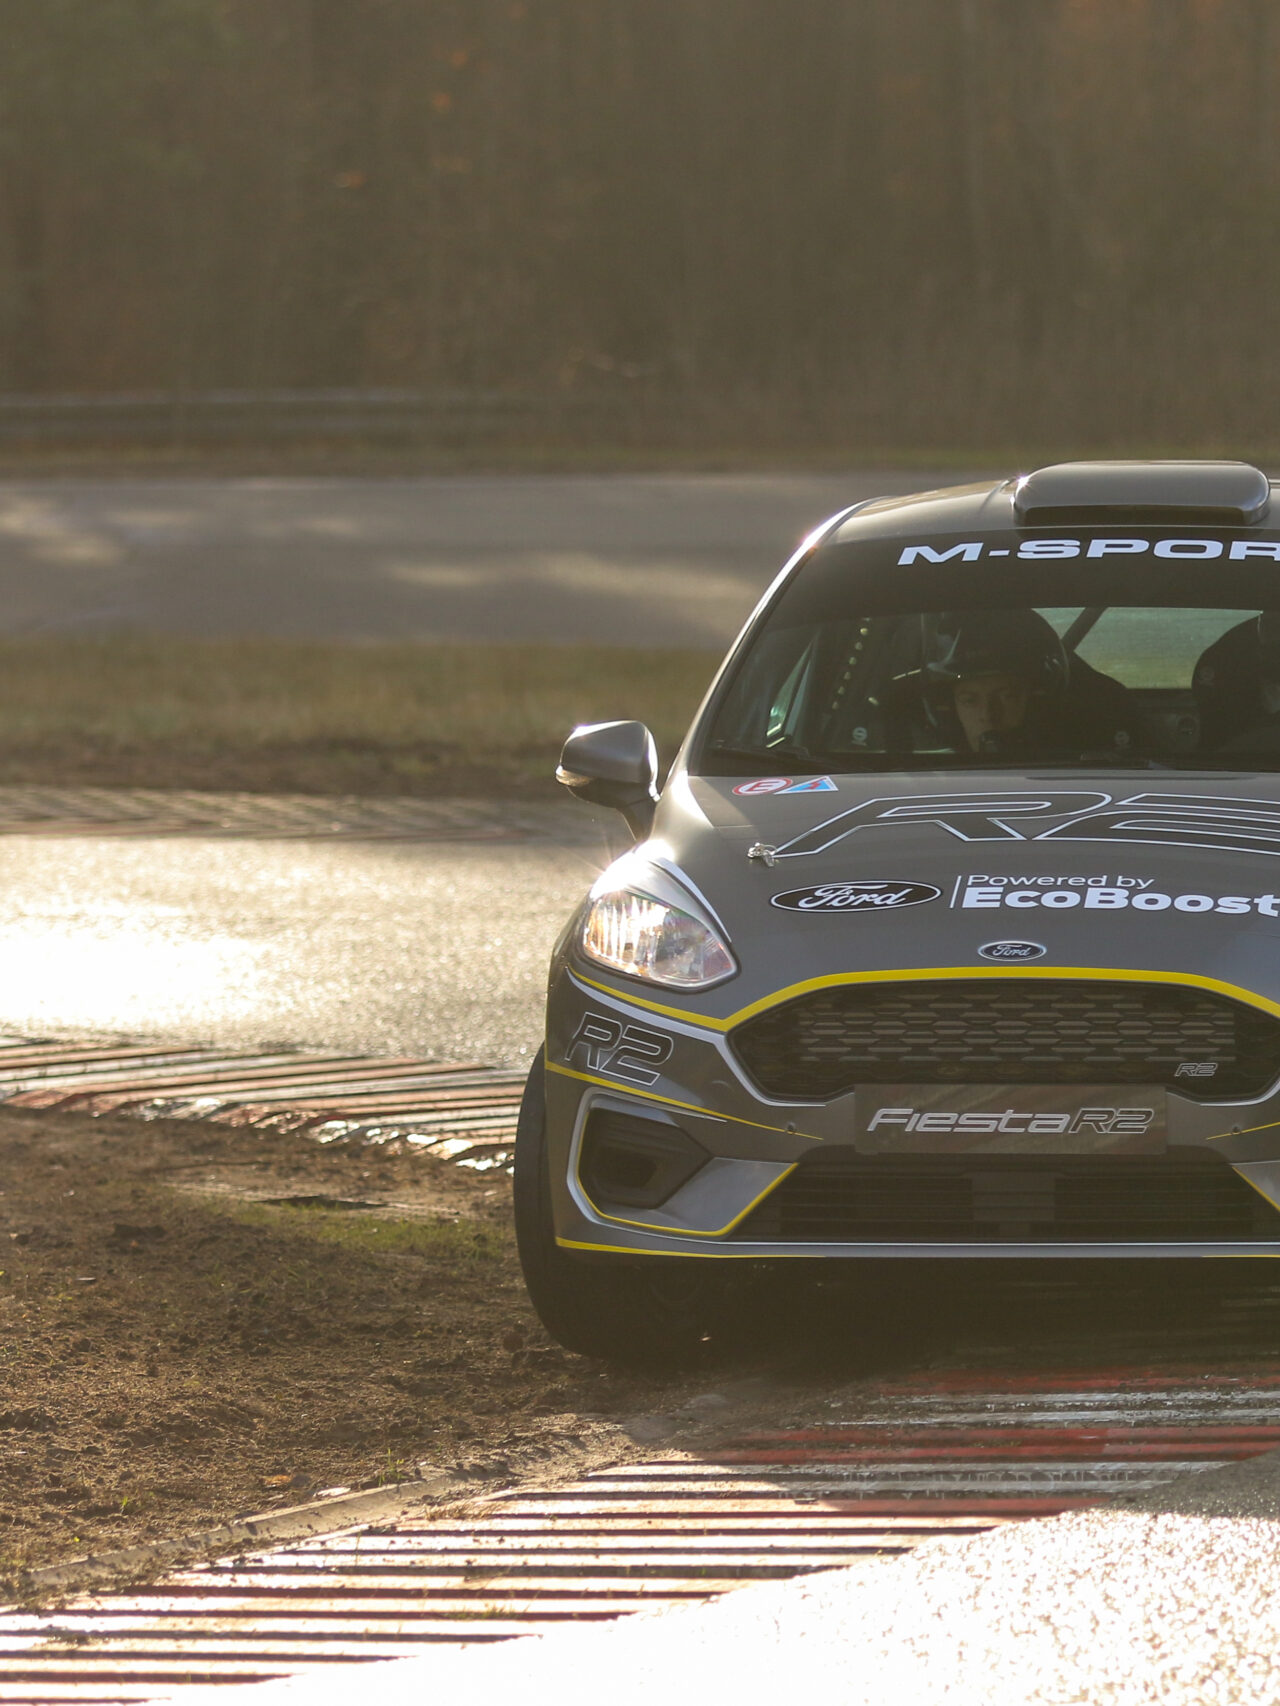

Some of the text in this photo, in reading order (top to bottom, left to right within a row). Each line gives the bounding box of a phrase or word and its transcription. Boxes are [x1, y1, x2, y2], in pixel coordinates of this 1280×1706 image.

[966, 875, 1155, 889] Powered by
[798, 884, 913, 908] Ford
[961, 887, 1280, 917] EcoBoost
[564, 1011, 674, 1086] R2
